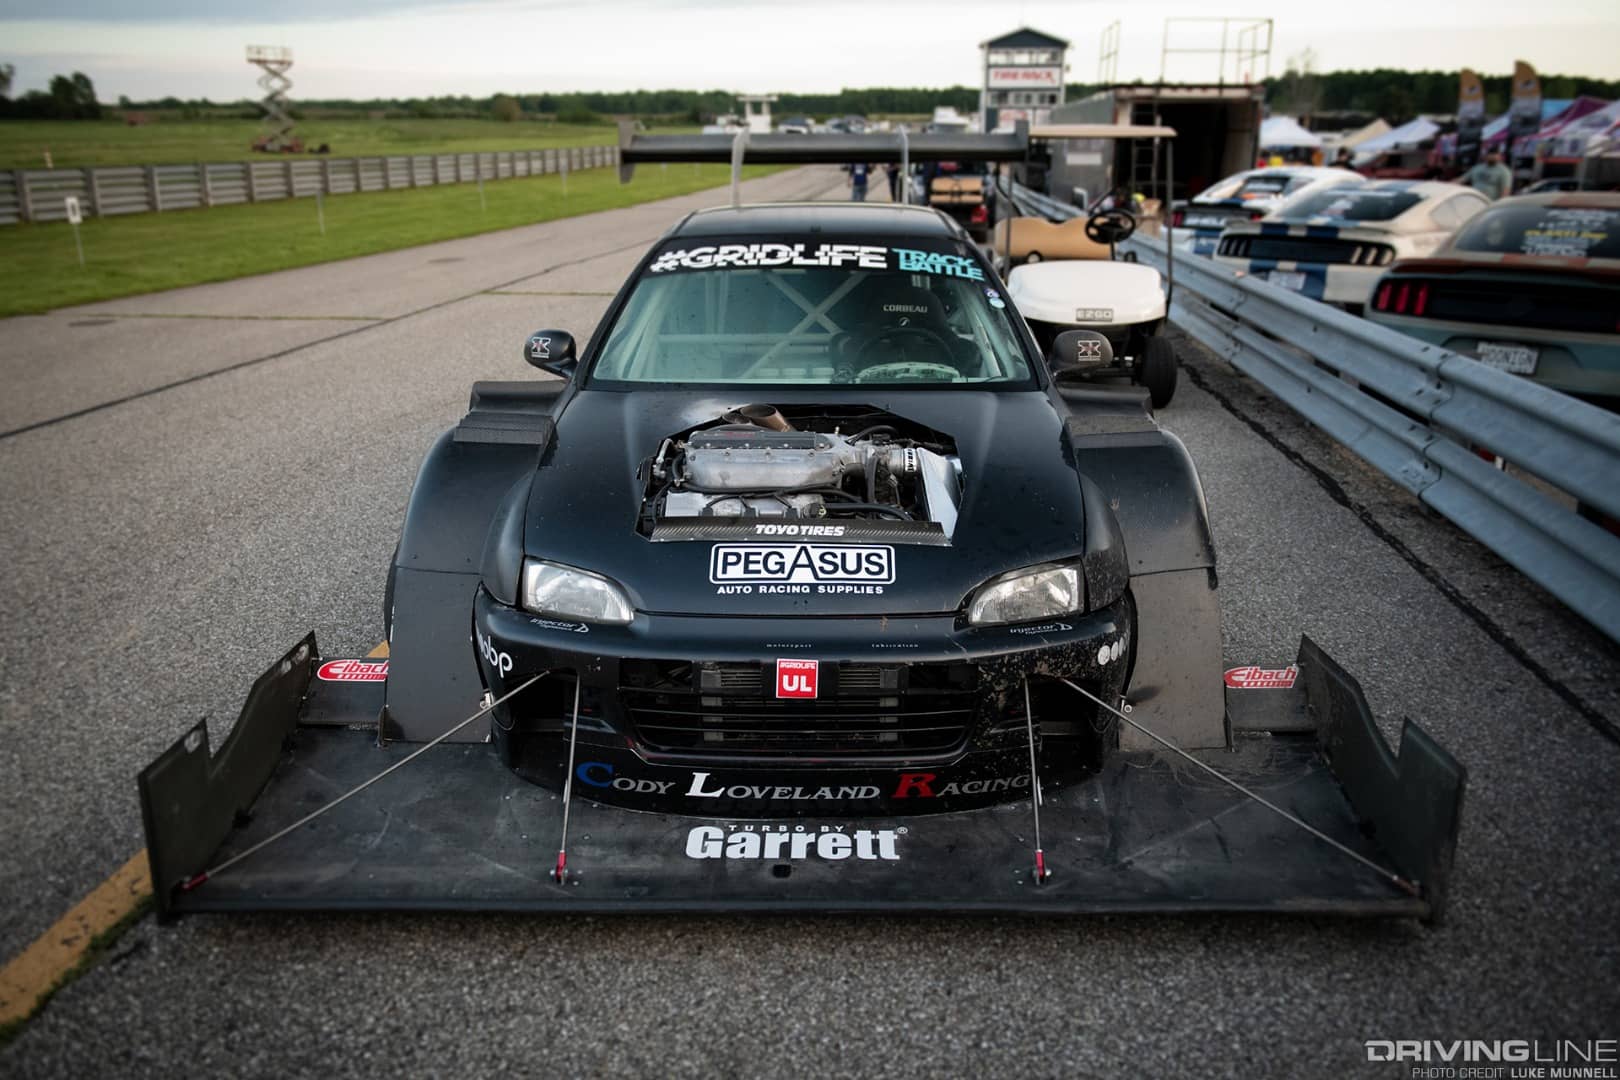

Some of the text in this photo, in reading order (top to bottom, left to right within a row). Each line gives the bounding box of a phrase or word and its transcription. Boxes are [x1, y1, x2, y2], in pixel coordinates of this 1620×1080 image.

[650, 243, 888, 273] #GRIDLIFE
[891, 248, 976, 268] TRACK
[899, 260, 985, 282] BATTLE
[883, 304, 928, 313] CORBEAU
[755, 524, 845, 537] TOYO TIRES
[720, 545, 886, 581] PEGASUS
[717, 585, 884, 594] AUTO RACING SUPPLIES
[783, 674, 812, 693] UL
[1224, 666, 1297, 688] Eibach
[685, 826, 901, 860] Garrett
